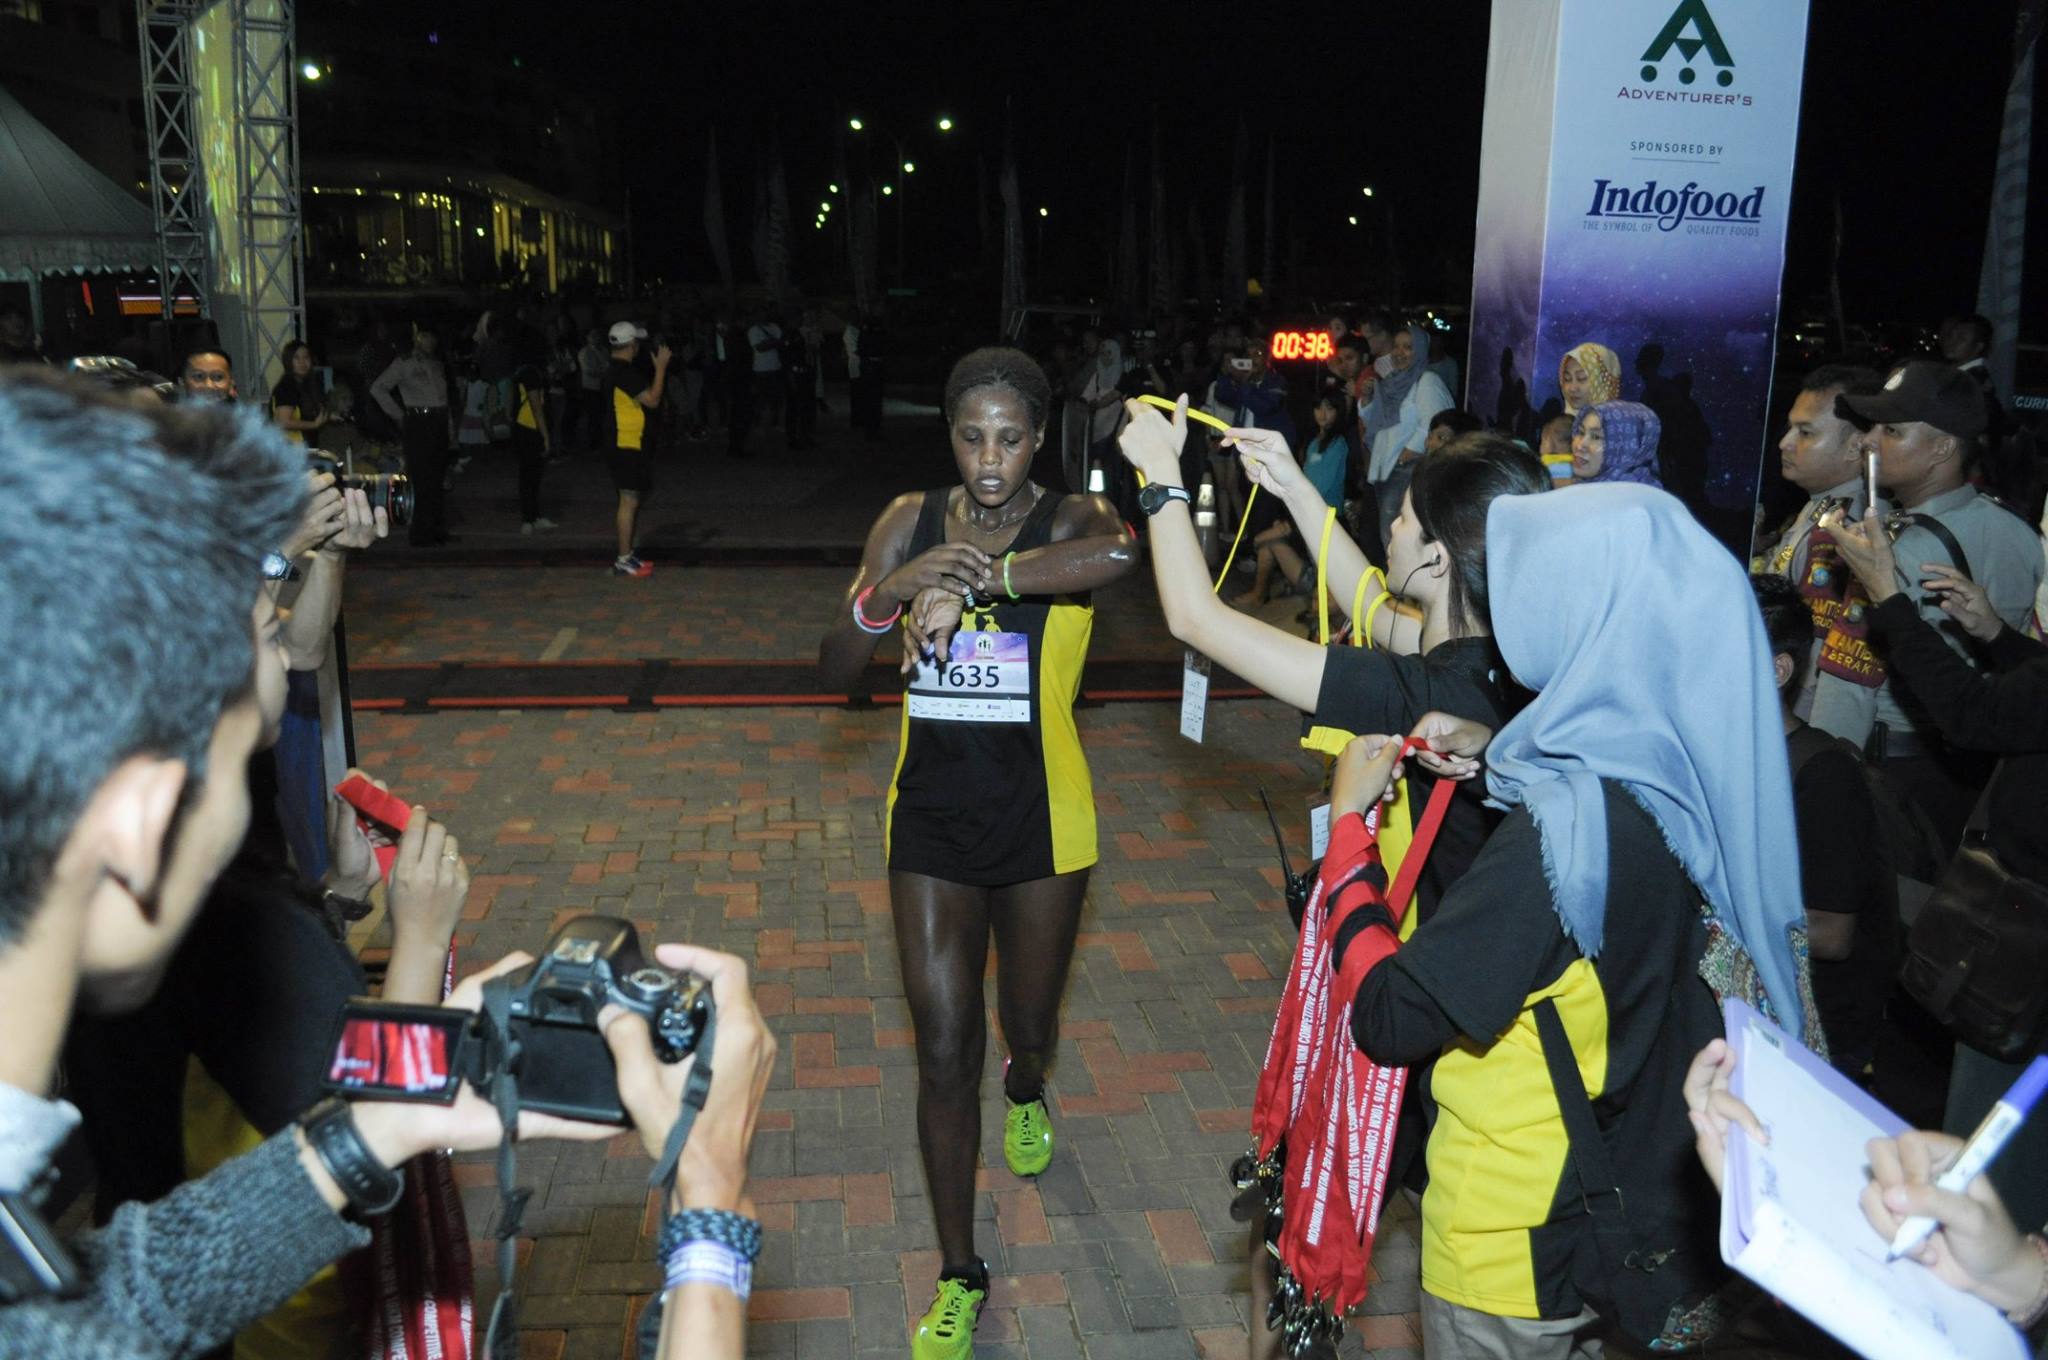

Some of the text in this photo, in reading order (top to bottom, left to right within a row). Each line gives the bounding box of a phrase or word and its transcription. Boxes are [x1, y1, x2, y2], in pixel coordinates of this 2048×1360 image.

[1617, 86, 1753, 106] ADVENTURER'S
[1630, 141, 1723, 155] SPONSORED BY
[1586, 179, 1766, 232] Indofood
[1583, 220, 1760, 237] THE SYMBOL OF QUALITY FOODS
[934, 664, 1000, 688] 1635
[1301, 946, 1315, 967] 2016
[1299, 993, 1315, 1043] COMPETITIVE
[1294, 1043, 1310, 1065] 10KM
[1292, 1064, 1305, 1084] 2016
[1373, 1079, 1388, 1103] 2016
[1368, 1103, 1384, 1129] 10KM
[1348, 1131, 1359, 1157] 10KM
[1322, 1146, 1334, 1171] 2016
[1348, 1158, 1360, 1178] 2016
[1363, 1128, 1380, 1186] COMPETITIVE
[1315, 1168, 1330, 1201] BINTAN
[1374, 1170, 1384, 1192] RUN
[1306, 1199, 1324, 1245] MOONRUN
